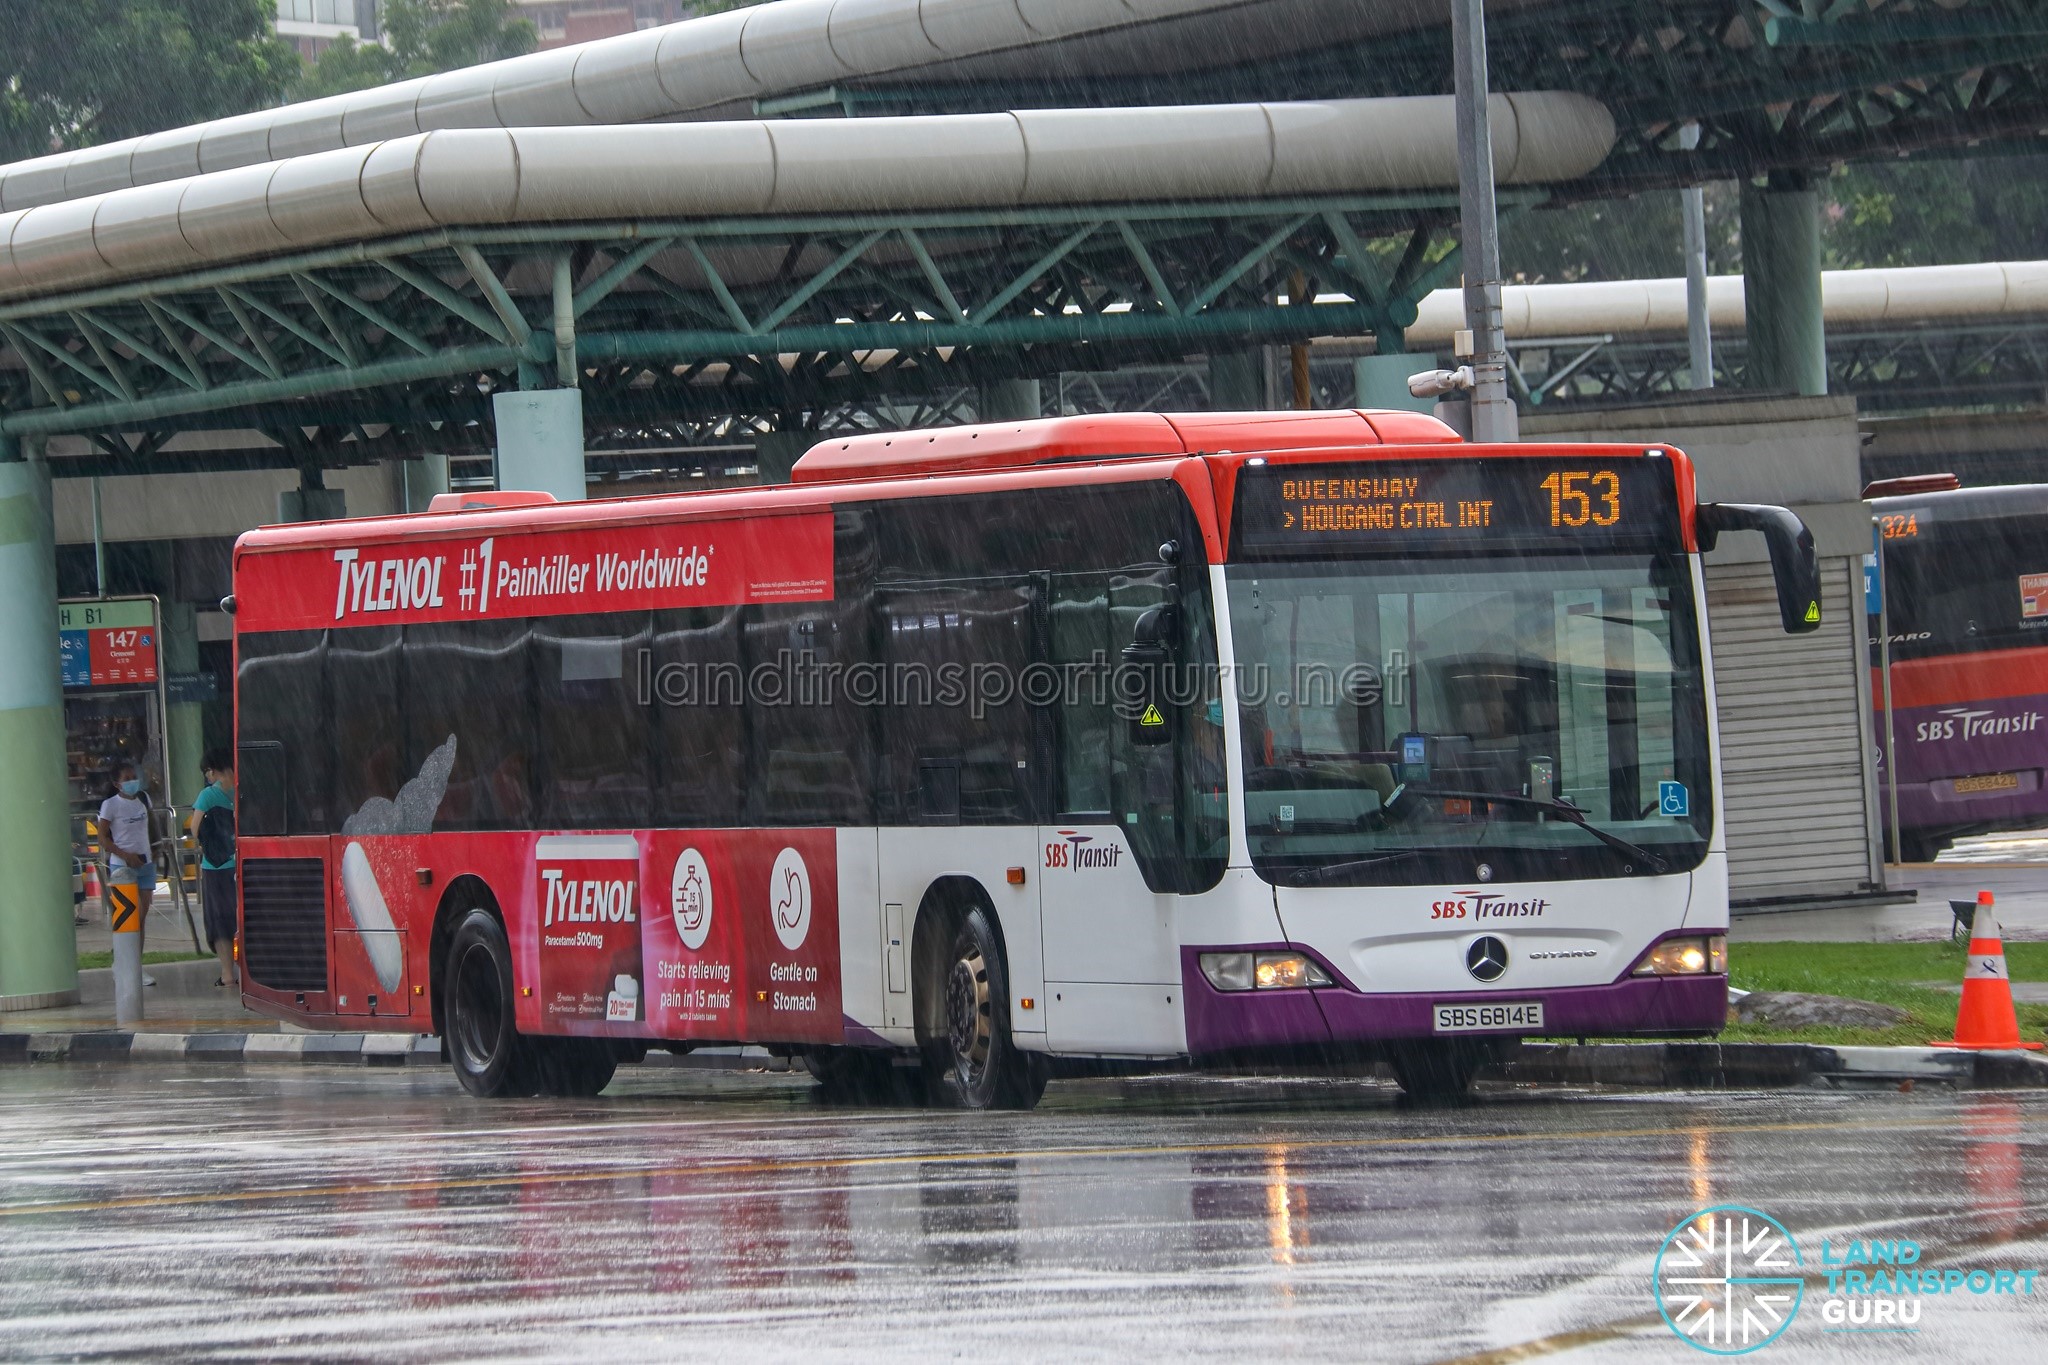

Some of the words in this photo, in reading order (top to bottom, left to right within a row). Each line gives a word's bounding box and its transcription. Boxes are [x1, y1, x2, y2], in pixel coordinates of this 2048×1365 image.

[1283, 477, 1418, 500] QUEENSWAY
[1540, 471, 1620, 528] 153
[1302, 503, 1393, 531] HOUGANG
[1400, 502, 1452, 529] CTRL
[1458, 501, 1493, 528] INT
[459, 537, 494, 613] #1
[496, 554, 590, 598] Painkiller
[85, 608, 102, 624] B1
[106, 631, 137, 647] 147
[1917, 719, 1954, 742] SBS
[1952, 710, 2045, 741] Transit
[1045, 843, 1068, 867] SBS
[1066, 836, 1123, 873] Transit
[542, 869, 636, 927] TYLENOL
[690, 892, 696, 902] 15
[688, 904, 698, 912] min
[1431, 901, 1467, 920] SBS
[1465, 895, 1552, 922] Transit
[545, 935, 576, 946] Paracetamol
[577, 931, 603, 949] 500mg
[1530, 949, 1598, 960] CITARO
[658, 960, 686, 979] Starts
[688, 960, 730, 983] relieving
[770, 961, 802, 981] Gentle
[805, 967, 817, 981] on
[610, 1000, 618, 1016] 20
[660, 988, 681, 1010] pain
[684, 988, 692, 1008] in
[695, 989, 705, 1008] 15
[774, 991, 816, 1011] Stomach
[706, 1013, 716, 1021] taken
